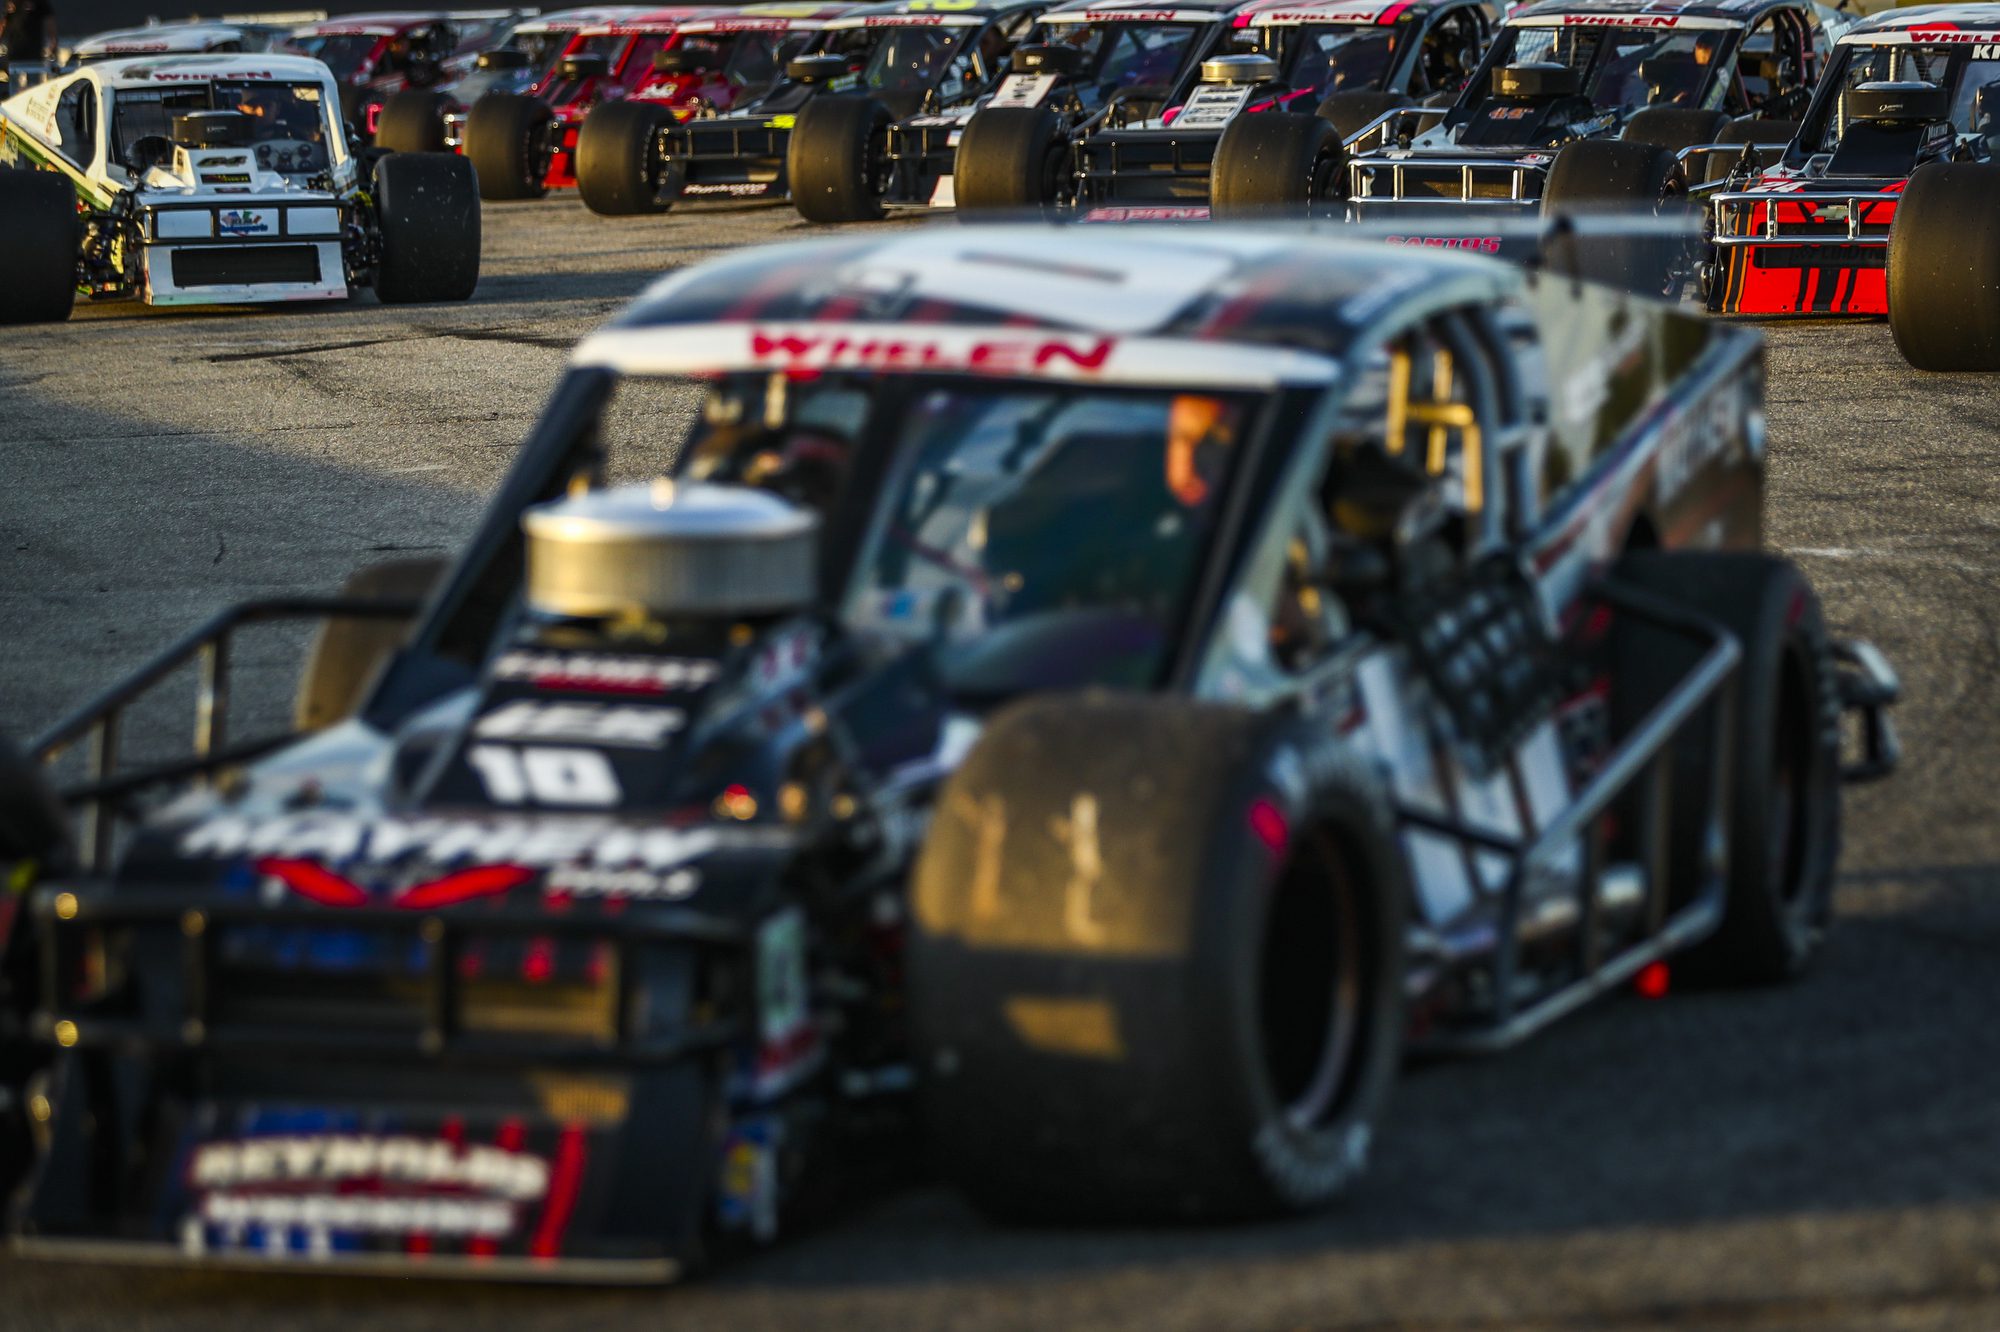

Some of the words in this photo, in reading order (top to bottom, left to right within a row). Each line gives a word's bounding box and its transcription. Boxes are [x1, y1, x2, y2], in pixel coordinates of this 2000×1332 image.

[1085, 11, 1176, 21] WHELEN
[1272, 12, 1374, 21] WHELEN
[1564, 16, 1679, 27] WHELEN
[154, 71, 272, 81] WHELEN
[1385, 235, 1502, 254] SANTOS
[751, 329, 1119, 375] WHELEN
[467, 743, 625, 808] 10
